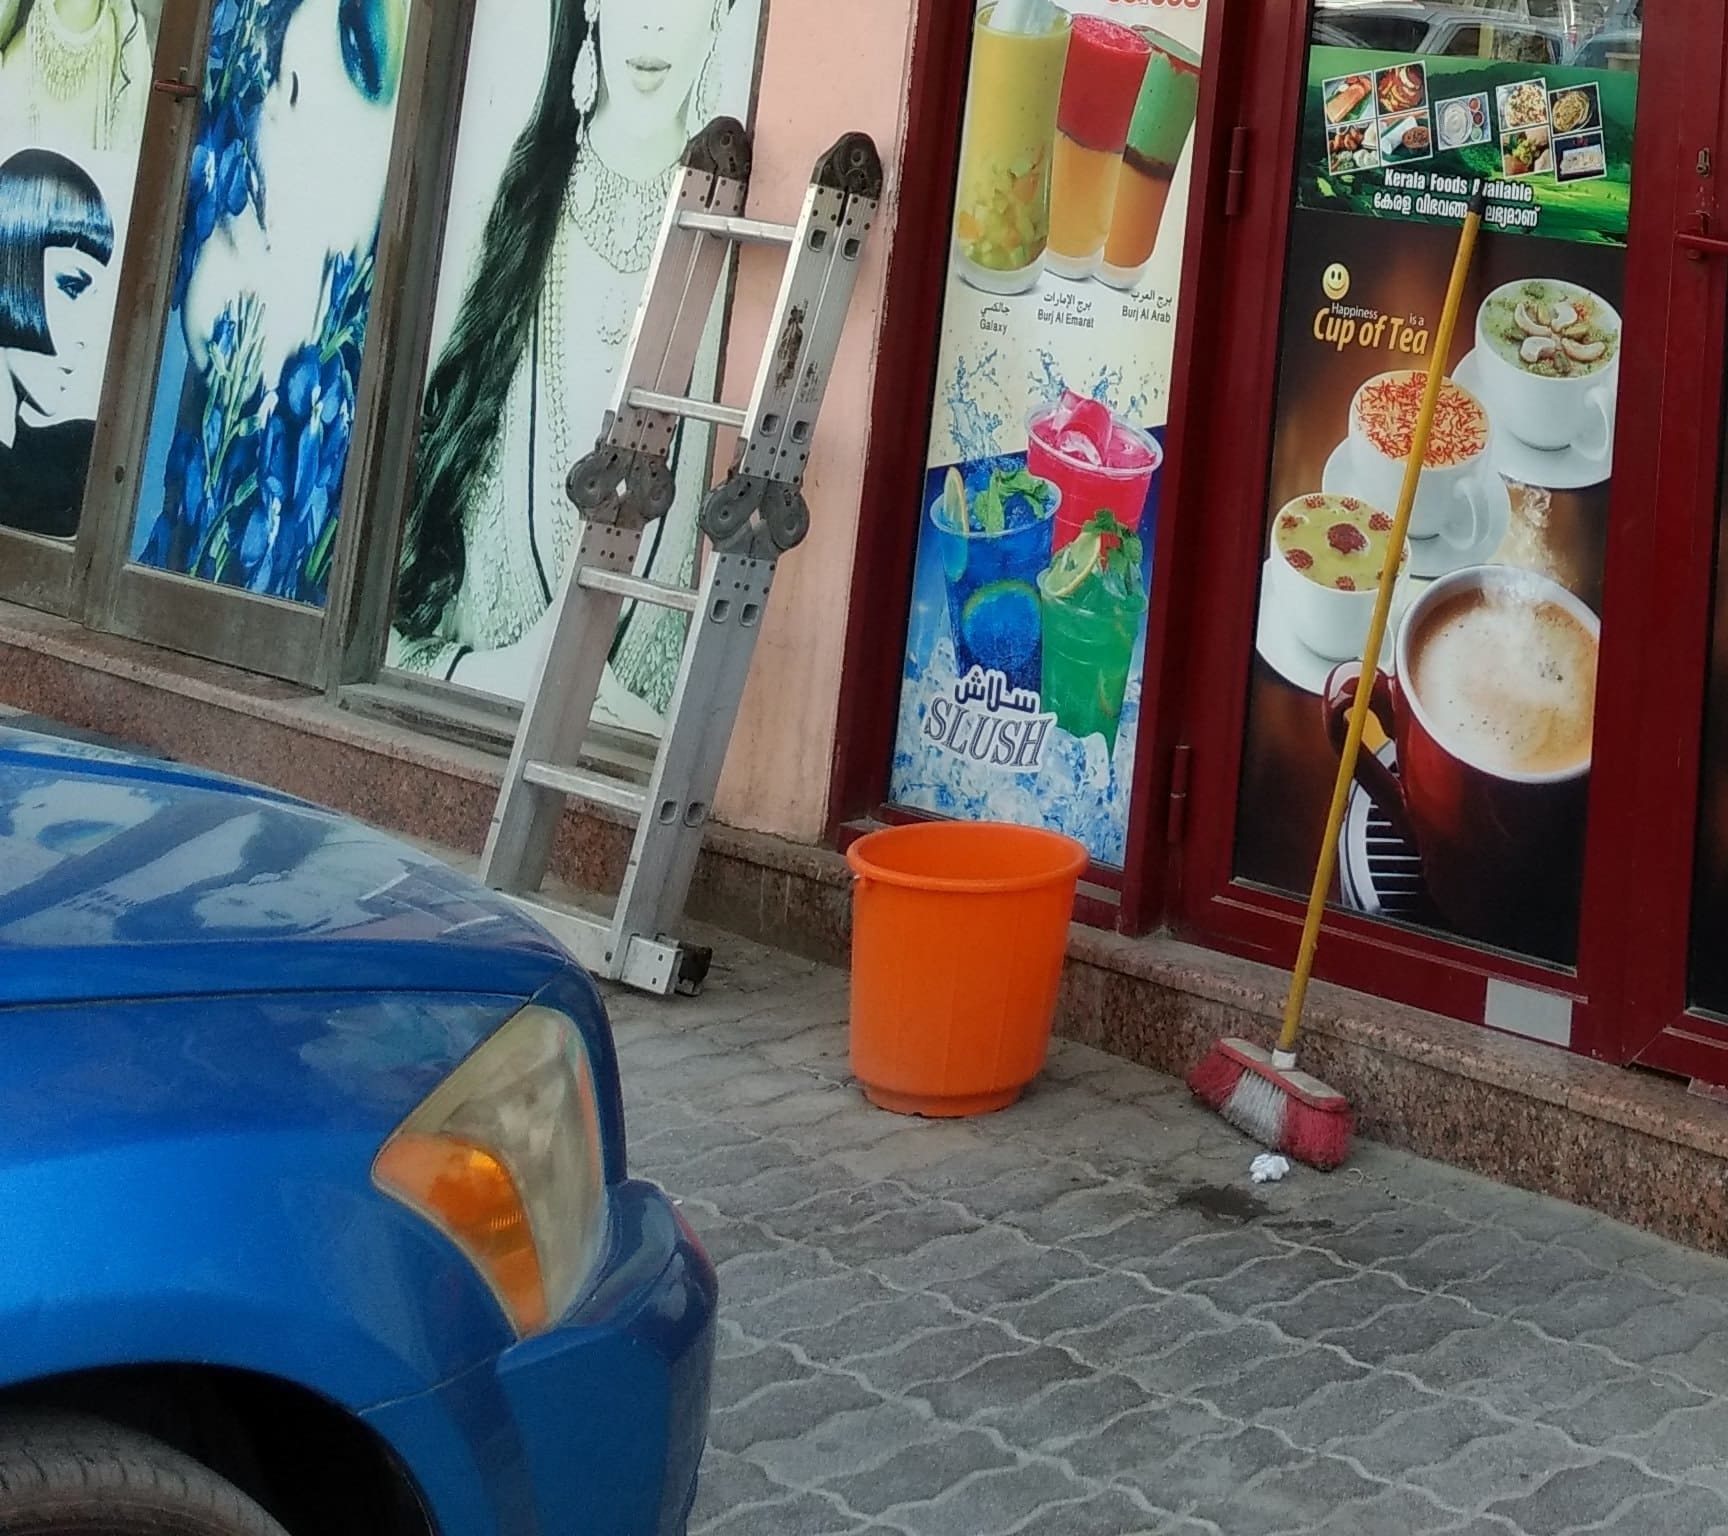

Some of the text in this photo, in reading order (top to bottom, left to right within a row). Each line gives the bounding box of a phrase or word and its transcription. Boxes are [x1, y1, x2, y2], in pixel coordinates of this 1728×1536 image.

[1384, 168, 1425, 189] Kerala
[1430, 173, 1467, 194] Foods
[979, 318, 1008, 335] Galaxy
[1037, 309, 1094, 328] Burj Al Emarat
[1122, 305, 1171, 323] Burj Al Arab
[1331, 302, 1425, 326] Happiness is a
[1313, 308, 1429, 354] Cup of Tea
[955, 671, 1036, 714] سلاش
[923, 696, 1054, 767] SLUSH
